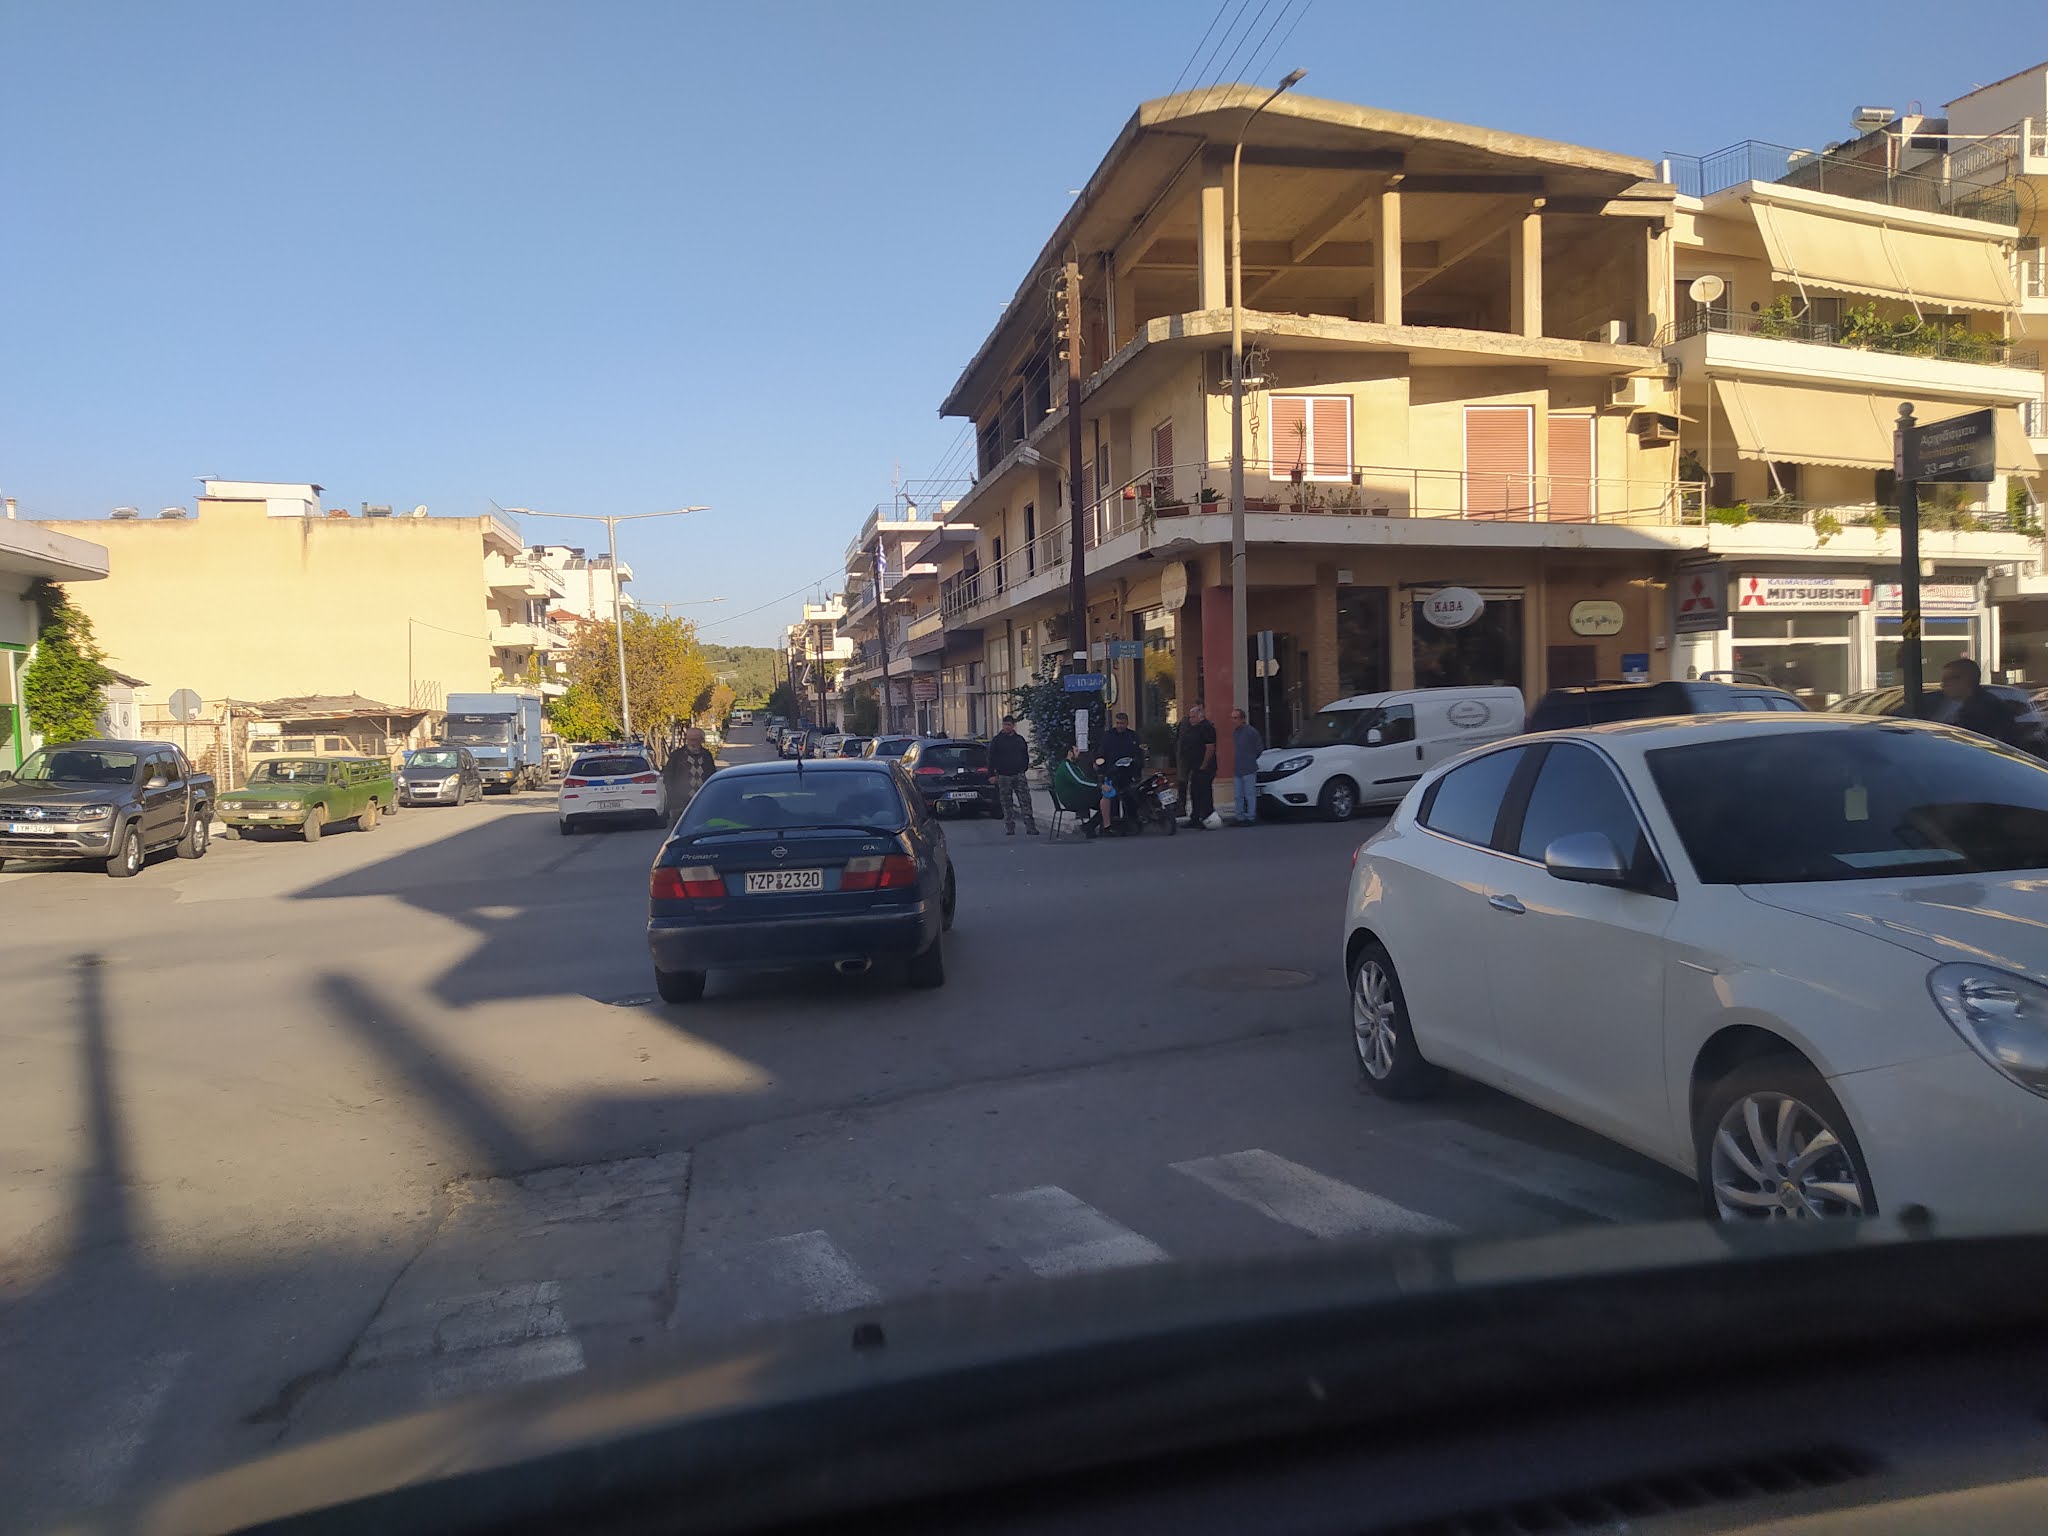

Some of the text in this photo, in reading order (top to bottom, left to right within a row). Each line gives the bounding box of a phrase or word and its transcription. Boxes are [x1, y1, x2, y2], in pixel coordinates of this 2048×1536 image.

[1924, 463, 1937, 475] 33
[1767, 588, 1861, 599] MITSUBISHI
[680, 853, 720, 861] Primera
